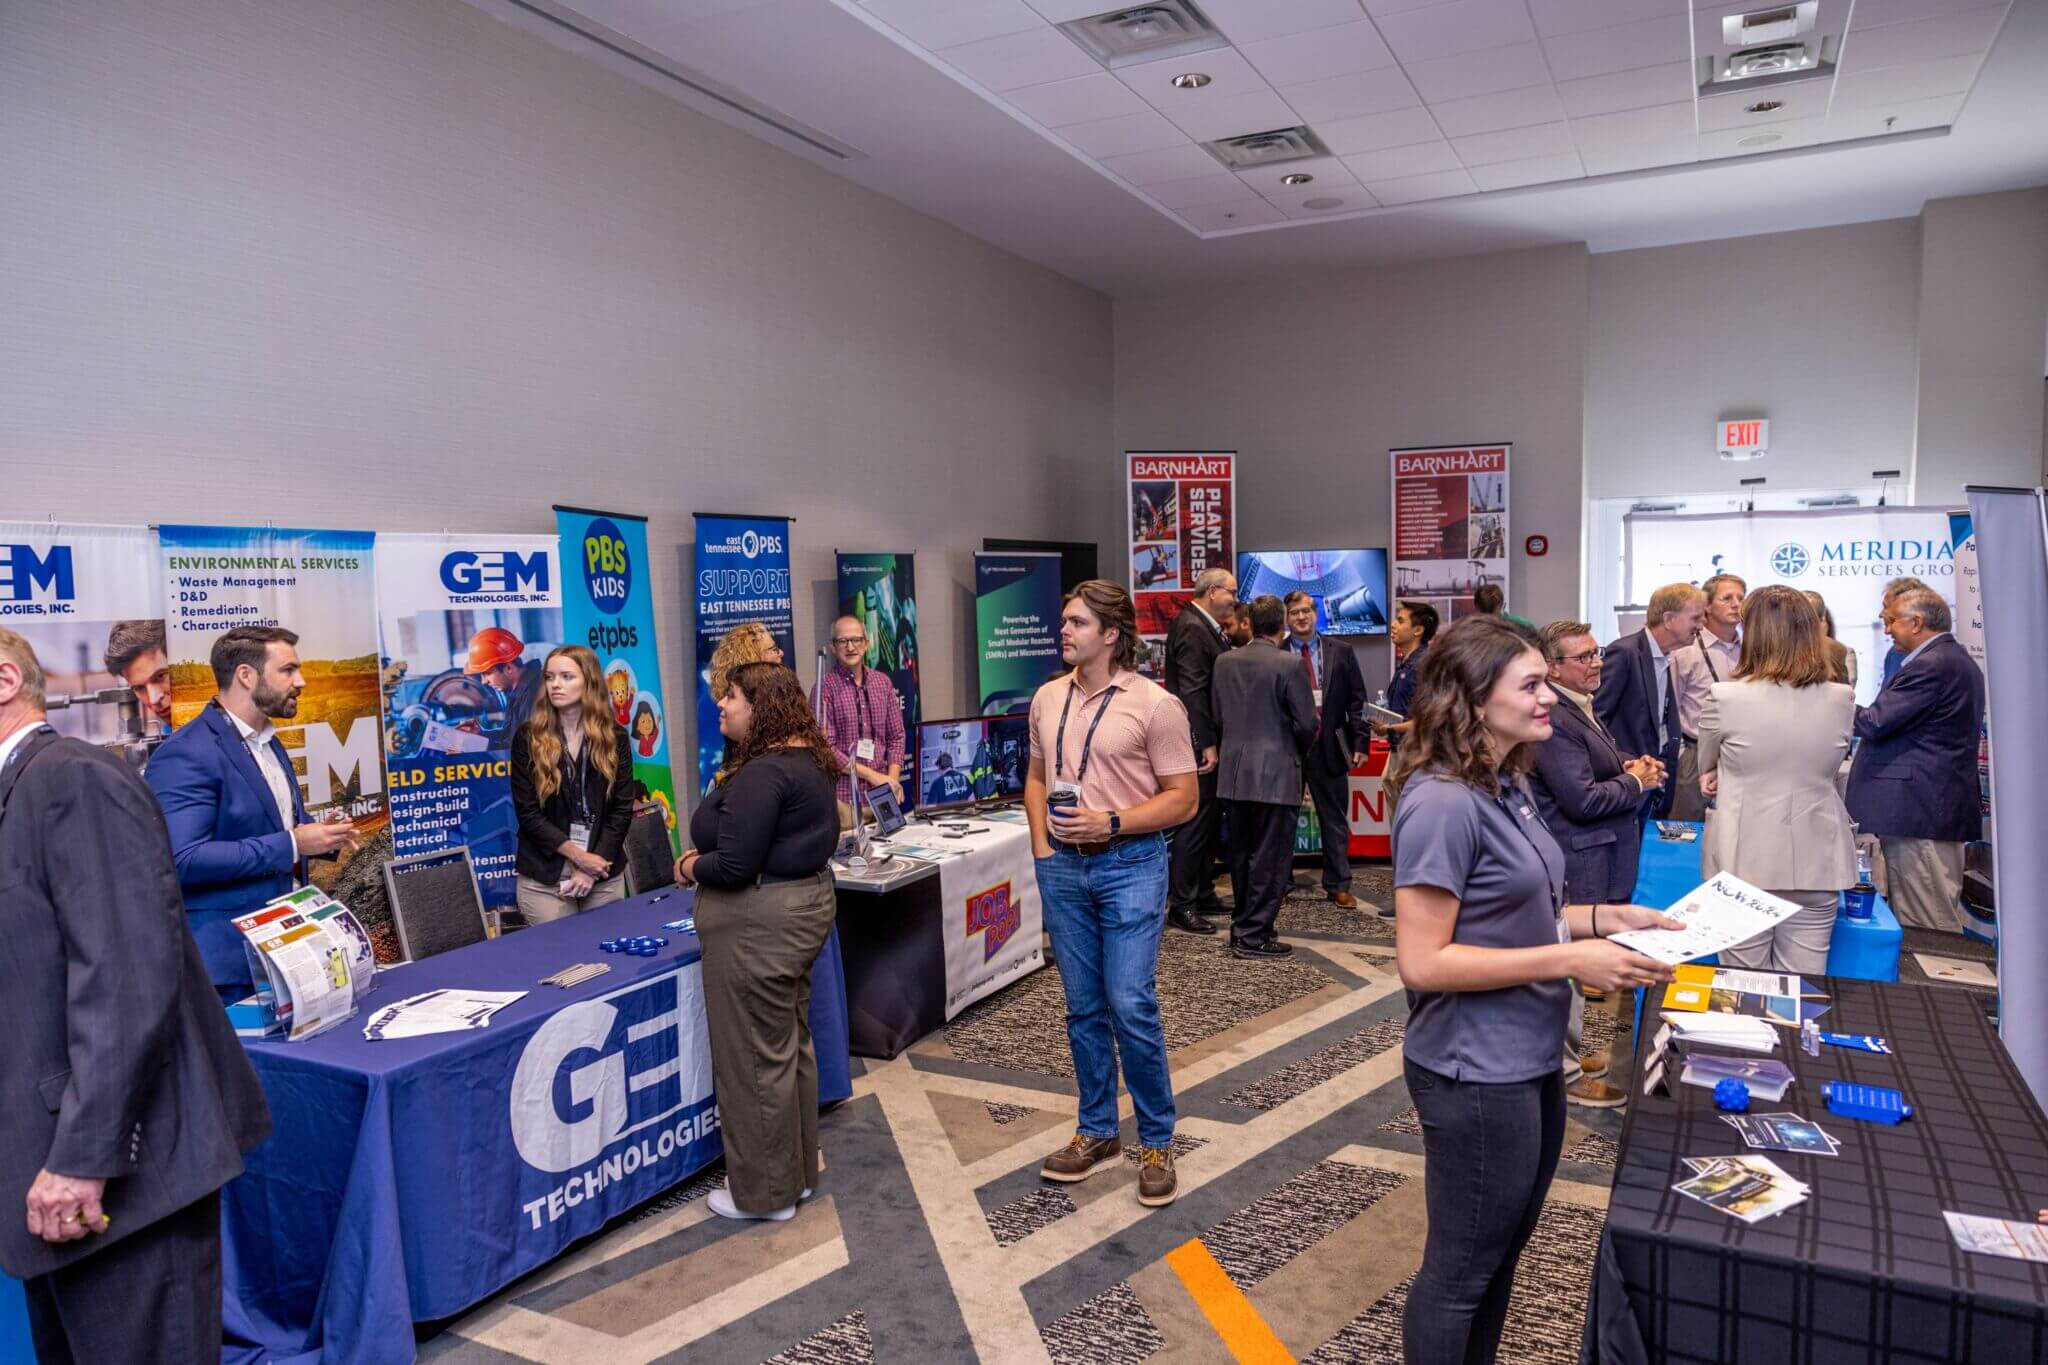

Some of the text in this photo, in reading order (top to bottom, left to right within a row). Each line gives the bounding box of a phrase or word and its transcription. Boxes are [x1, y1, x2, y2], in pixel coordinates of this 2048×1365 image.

[1727, 422, 1760, 447] EXIT
[1135, 457, 1228, 478] BARNHART
[1399, 450, 1502, 474] BARNHART
[1206, 488, 1222, 552] PLANT
[726, 536, 741, 544] east
[1190, 487, 1206, 583] SERVICES
[705, 535, 782, 554] tennessee PBS
[585, 535, 626, 575] PBS
[169, 557, 359, 570] ENVIRONMENTAL SERVICES
[1818, 564, 1903, 577] SERVICES
[440, 551, 549, 594] GEM
[179, 577, 296, 589] Waste Management
[592, 577, 625, 599] KIDS
[700, 569, 789, 597] SUPPORT
[179, 591, 208, 602] D&D
[448, 594, 549, 604] TECHNOLOGIES, INC.
[50, 603, 75, 613] INC.
[181, 605, 258, 617] Remediation
[700, 598, 791, 614] EAST TENNESSEE PBS
[1002, 615, 1040, 625] Powering the
[588, 618, 638, 655] etpbs
[994, 625, 1048, 636] Next Generation of
[987, 637, 1055, 648] Small Modular Reactors
[352, 800, 382, 817] INC.
